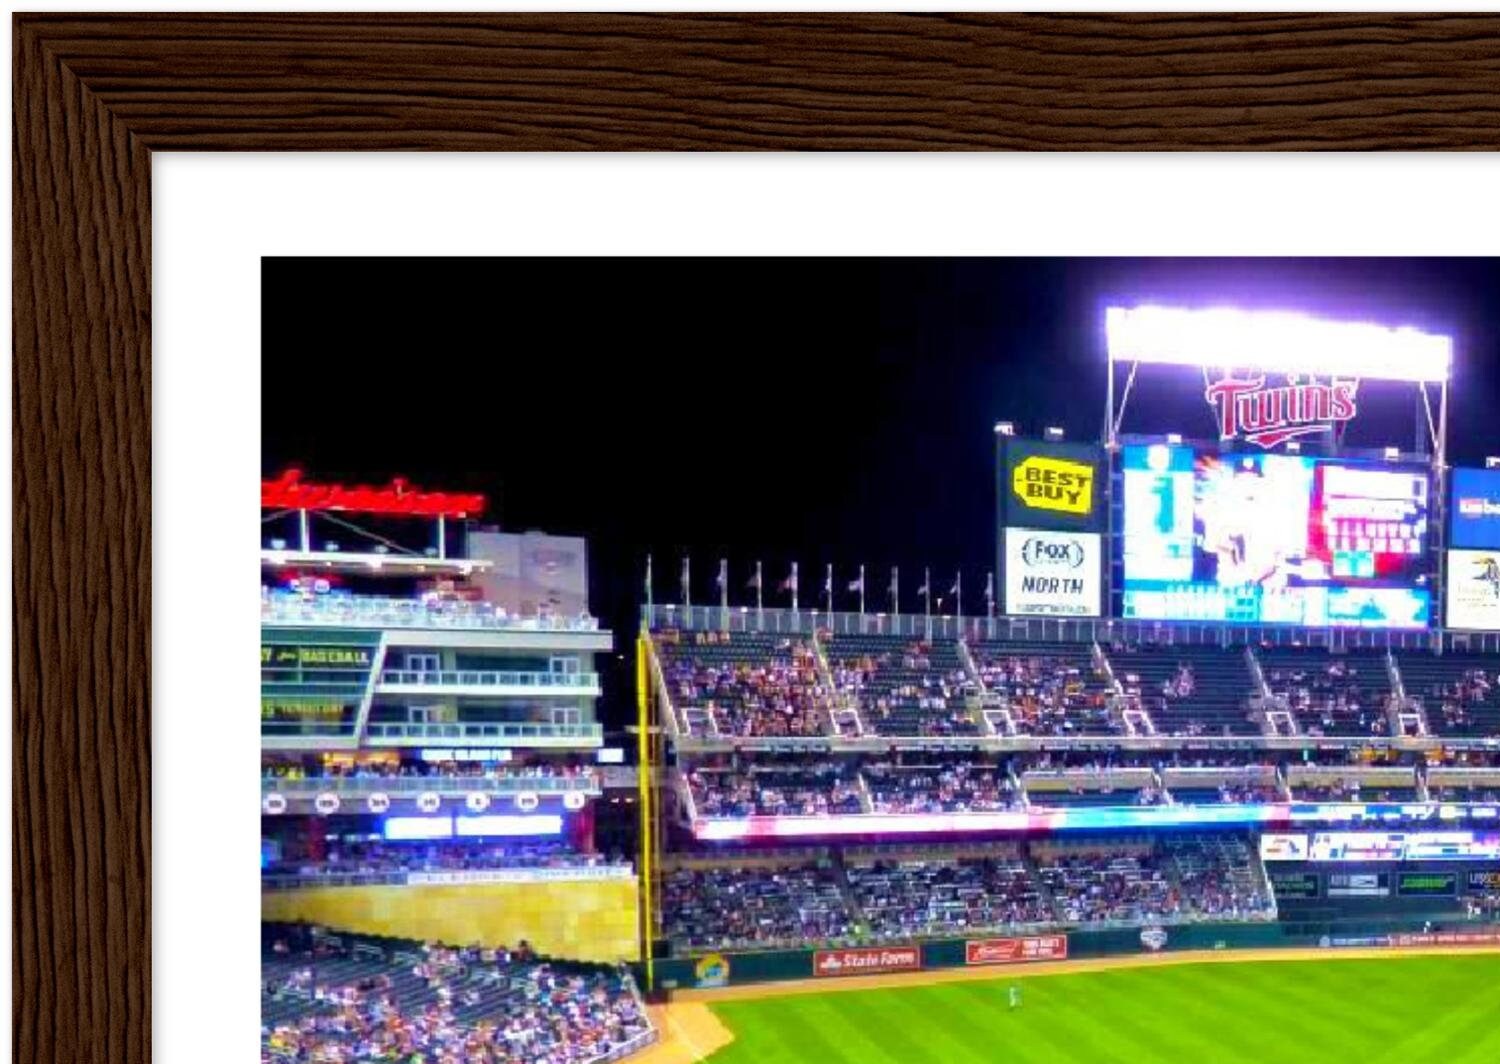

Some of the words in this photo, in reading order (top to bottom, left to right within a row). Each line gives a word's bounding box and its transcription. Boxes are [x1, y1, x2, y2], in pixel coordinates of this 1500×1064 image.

[1205, 374, 1357, 442] Twins
[1026, 467, 1091, 487] BEST
[1026, 483, 1081, 505] BUY
[1035, 540, 1070, 560] FOX
[1022, 575, 1084, 596] NORTH
[844, 952, 879, 967] State
[881, 951, 915, 966] Farm
